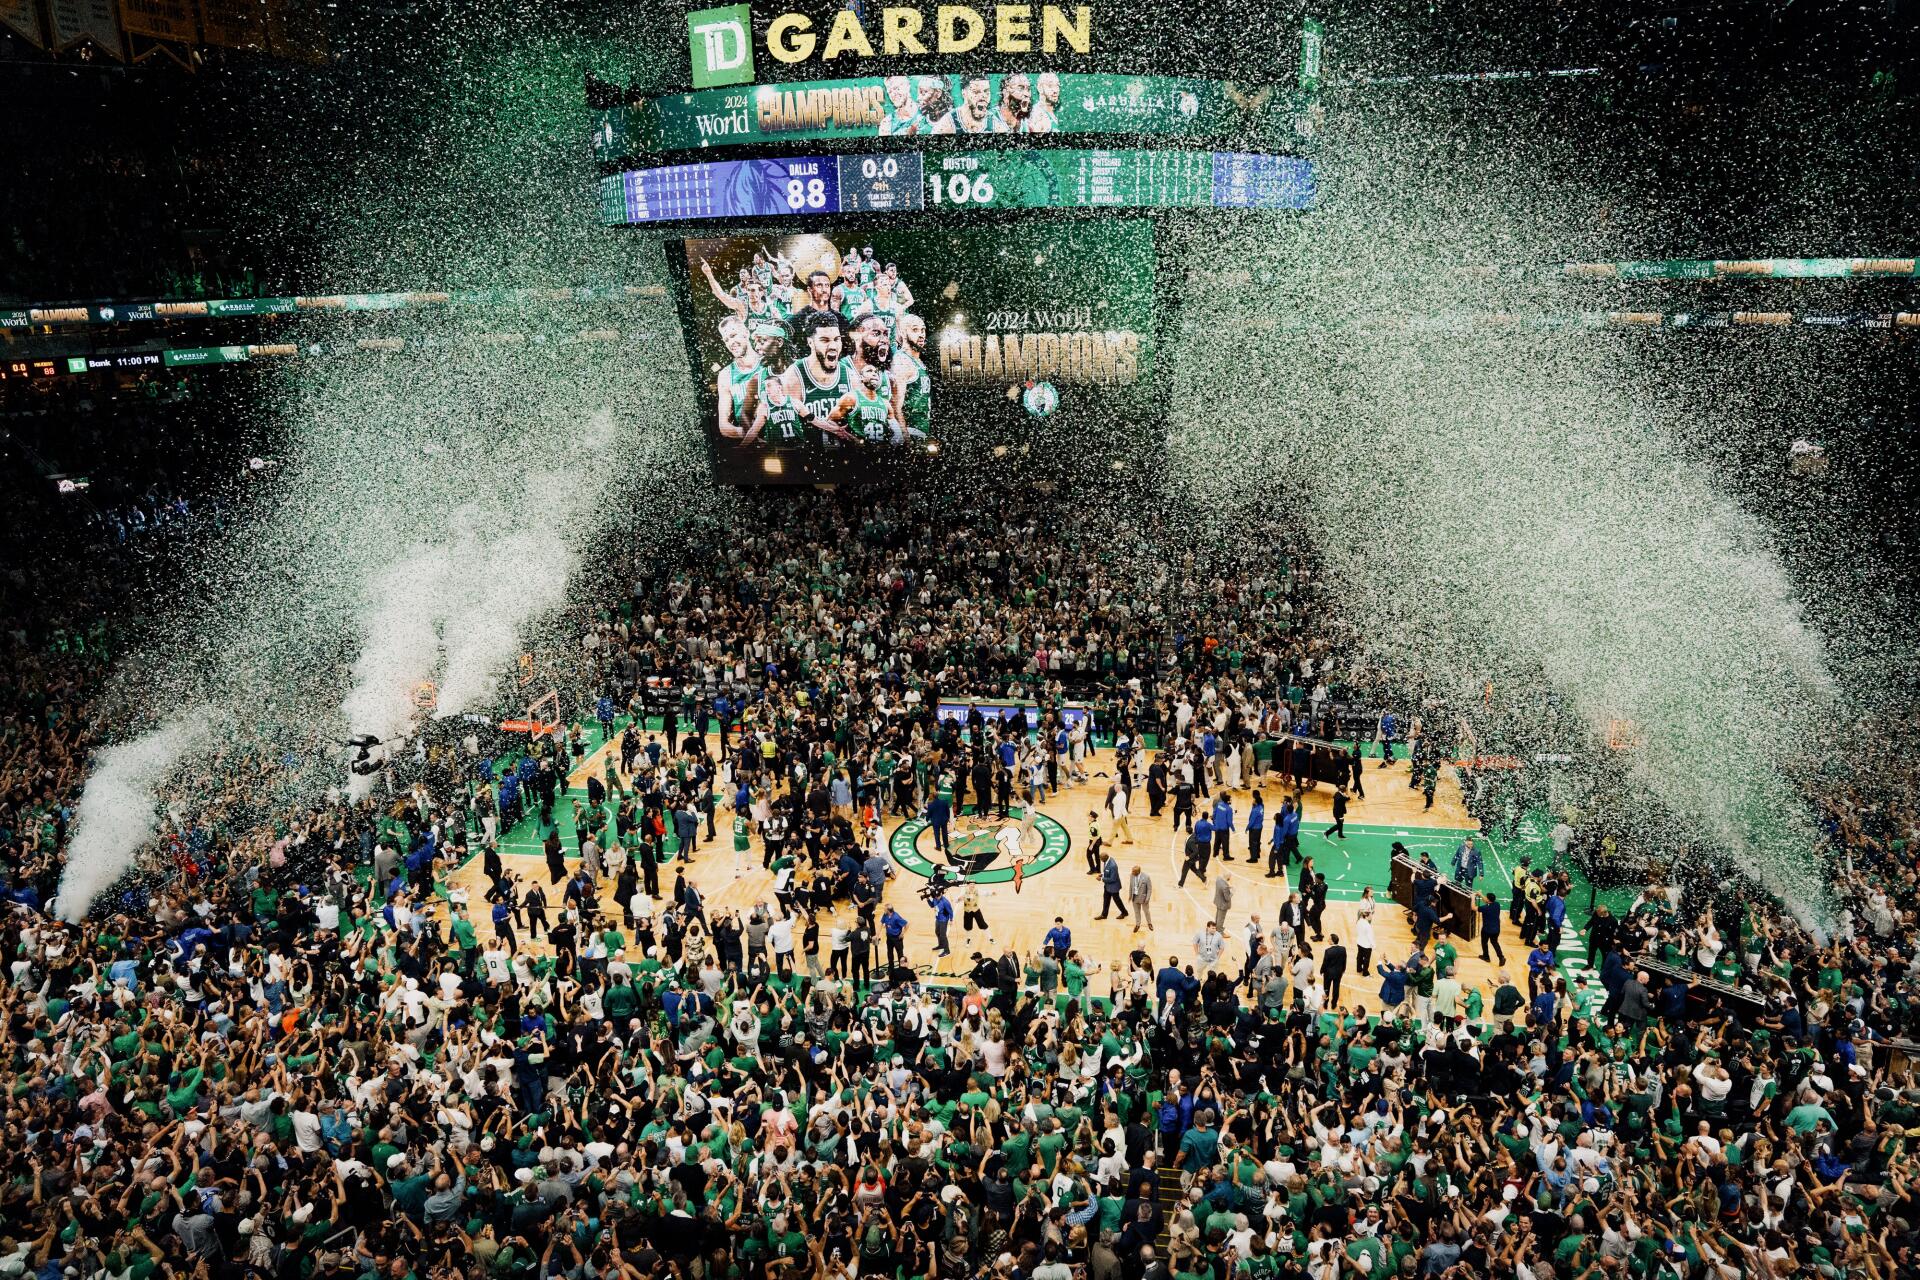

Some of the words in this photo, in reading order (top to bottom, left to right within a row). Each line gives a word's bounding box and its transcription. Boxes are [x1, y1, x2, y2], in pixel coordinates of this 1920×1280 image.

[694, 21, 746, 73] TD
[766, 3, 1092, 63] GARDEN
[724, 94, 748, 109] 2024
[696, 109, 750, 136] World
[756, 86, 885, 131] CHAMPIONS
[789, 163, 819, 176] DALLAS
[862, 158, 898, 179] 0.0
[942, 157, 978, 171] BOSTON
[787, 178, 826, 209] 88
[929, 173, 994, 204] 106
[128, 311, 153, 320] World
[155, 302, 208, 314] CHAMPIONS
[270, 303, 295, 313] World
[1, 317, 28, 327] World
[30, 308, 89, 321] CHAMPIONS
[985, 311, 1029, 330] 2024
[1034, 306, 1091, 328] World
[1864, 320, 1891, 328] World
[89, 359, 111, 368] Bank
[117, 357, 142, 367] 11:00
[144, 355, 159, 365] PM
[940, 331, 1138, 384] CHAMPIONS
[12, 363, 26, 372] 0.0
[44, 367, 54, 375] 88
[805, 399, 838, 421] BOST
[781, 423, 794, 438] 11
[1064, 713, 1074, 725] 26
